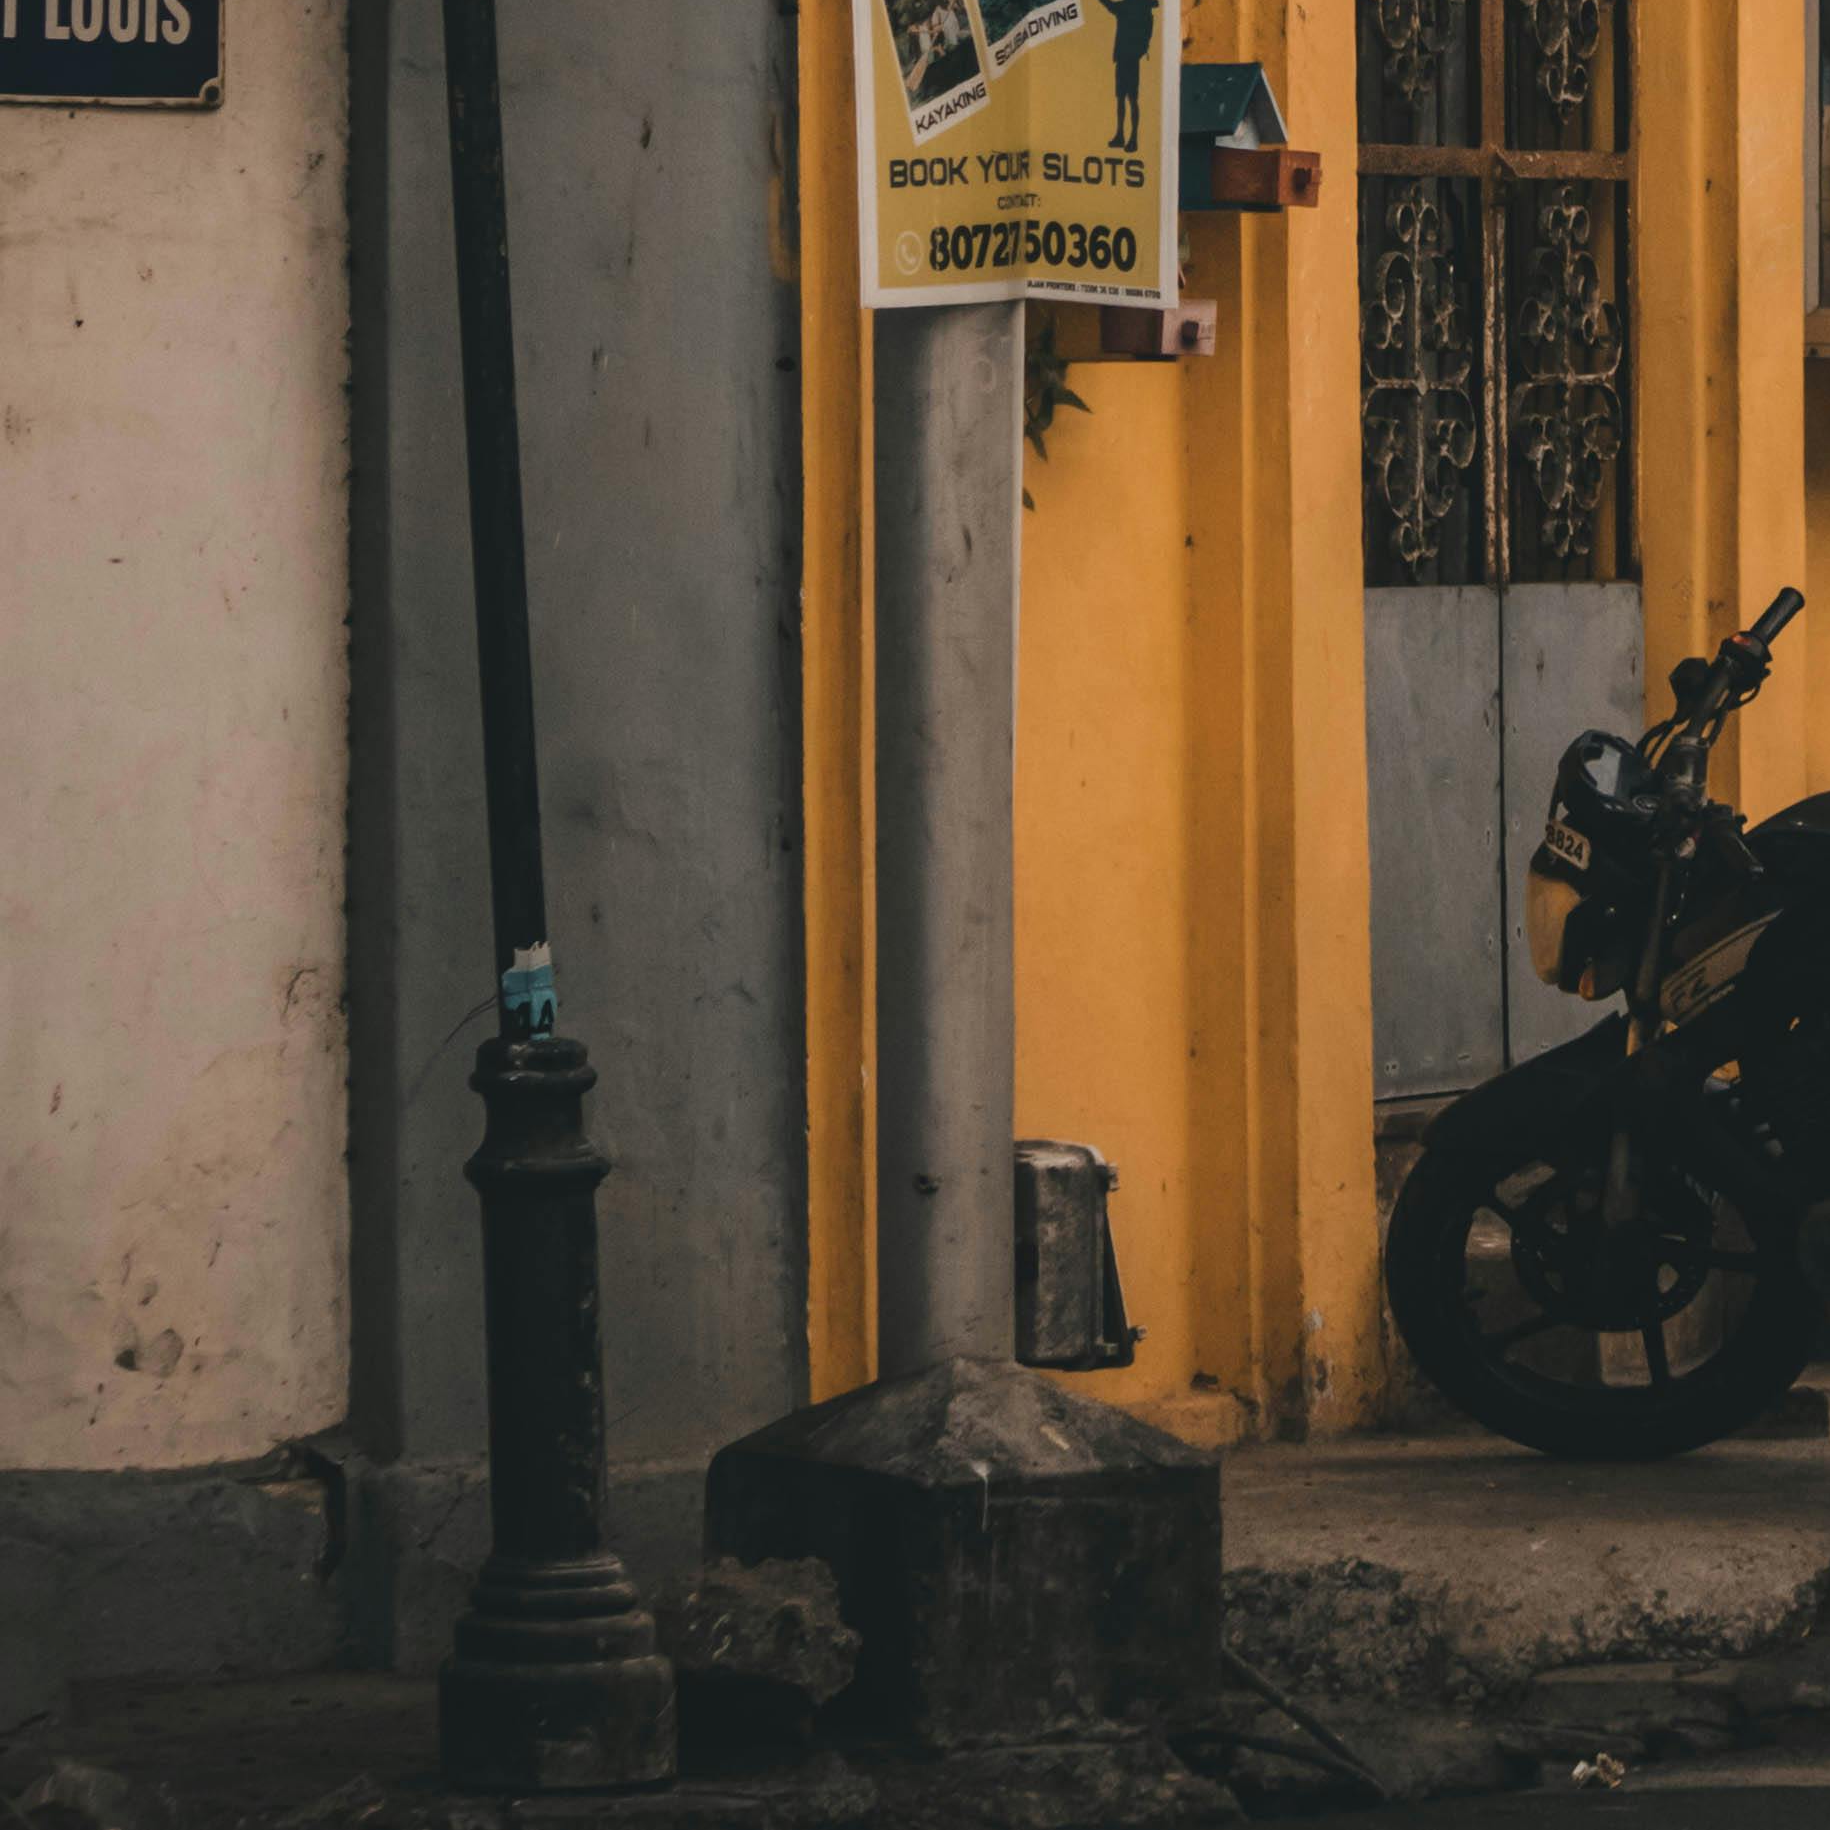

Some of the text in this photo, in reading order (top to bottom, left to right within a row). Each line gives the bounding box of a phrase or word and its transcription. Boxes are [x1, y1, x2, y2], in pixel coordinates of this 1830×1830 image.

[915, 82, 987, 134] KAYAKING
[889, 150, 1145, 189] BOOK YOUR SLOTS
[929, 219, 1138, 273] 8072750360
